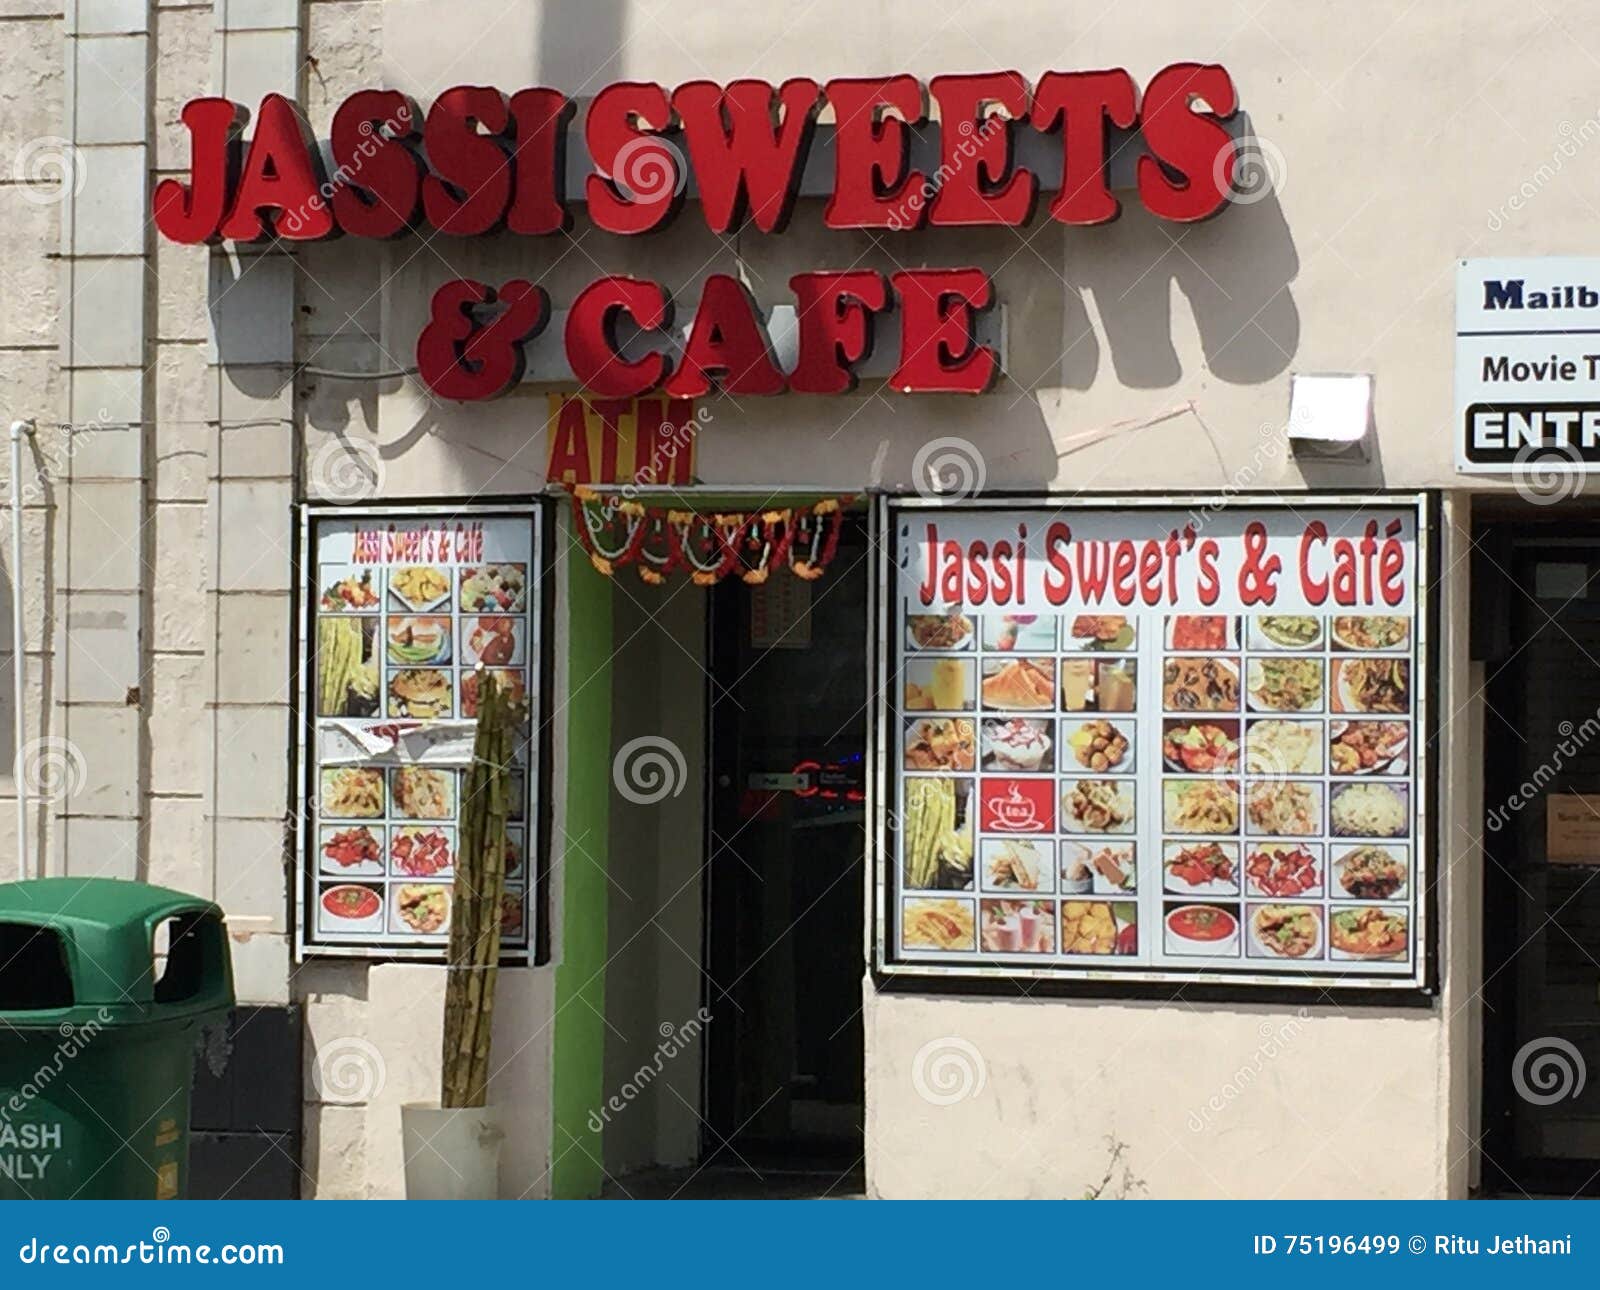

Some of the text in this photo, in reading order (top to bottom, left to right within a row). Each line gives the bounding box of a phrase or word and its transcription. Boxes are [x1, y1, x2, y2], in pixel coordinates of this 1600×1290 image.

[154, 62, 1238, 244] JASSI SWEETS
[1483, 280, 1600, 310] Mailb
[417, 267, 998, 402] & CAFE
[1483, 355, 1577, 382] Movie
[547, 399, 692, 485] ATM
[353, 523, 382, 563] Jassi
[919, 522, 1027, 606] Jassi
[1044, 520, 1221, 607] Sweet's
[1238, 520, 1282, 607] &
[1300, 518, 1405, 607] Café
[0, 1123, 61, 1149] ASH
